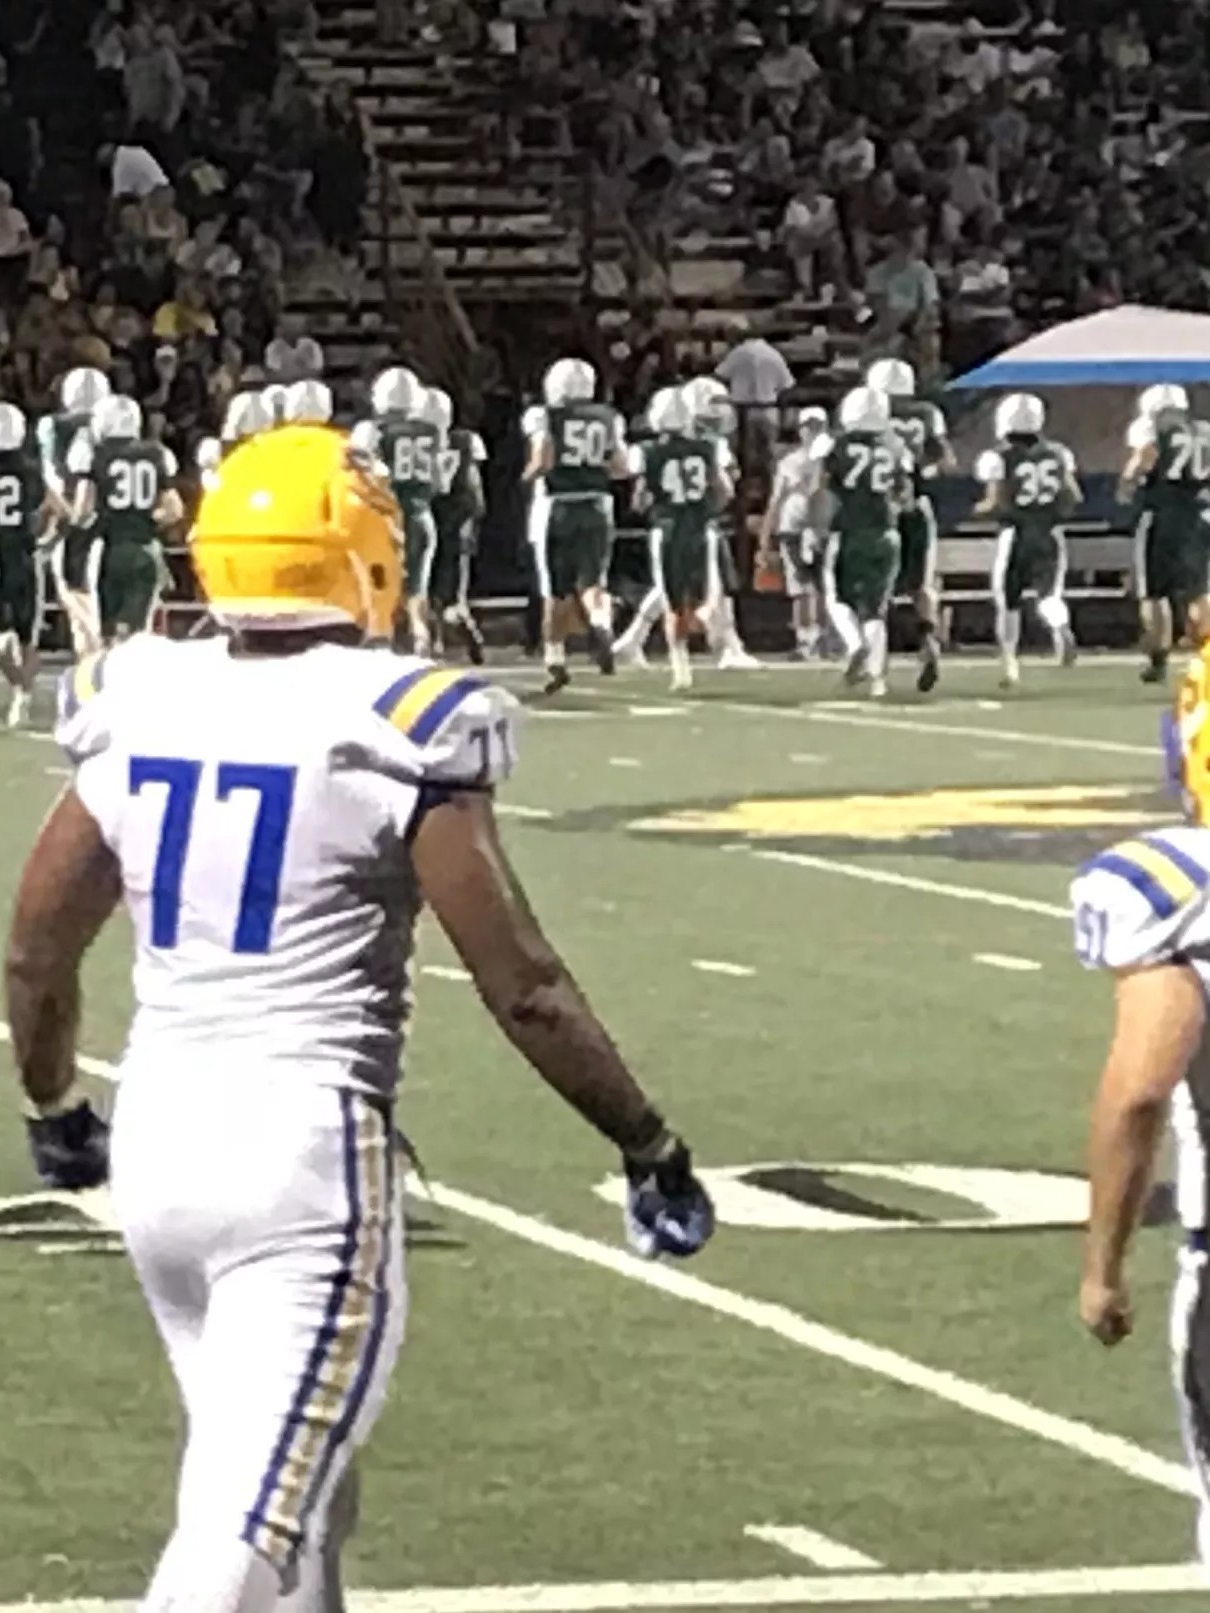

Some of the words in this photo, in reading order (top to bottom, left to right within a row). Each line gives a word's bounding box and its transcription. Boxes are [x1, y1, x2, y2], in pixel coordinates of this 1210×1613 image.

[394, 435, 433, 481] 85
[561, 419, 605, 466] 50
[107, 459, 157, 509] 30
[661, 455, 706, 504] 43
[843, 443, 894, 492] 72
[1014, 459, 1061, 506] 35
[129, 755, 297, 955] 77
